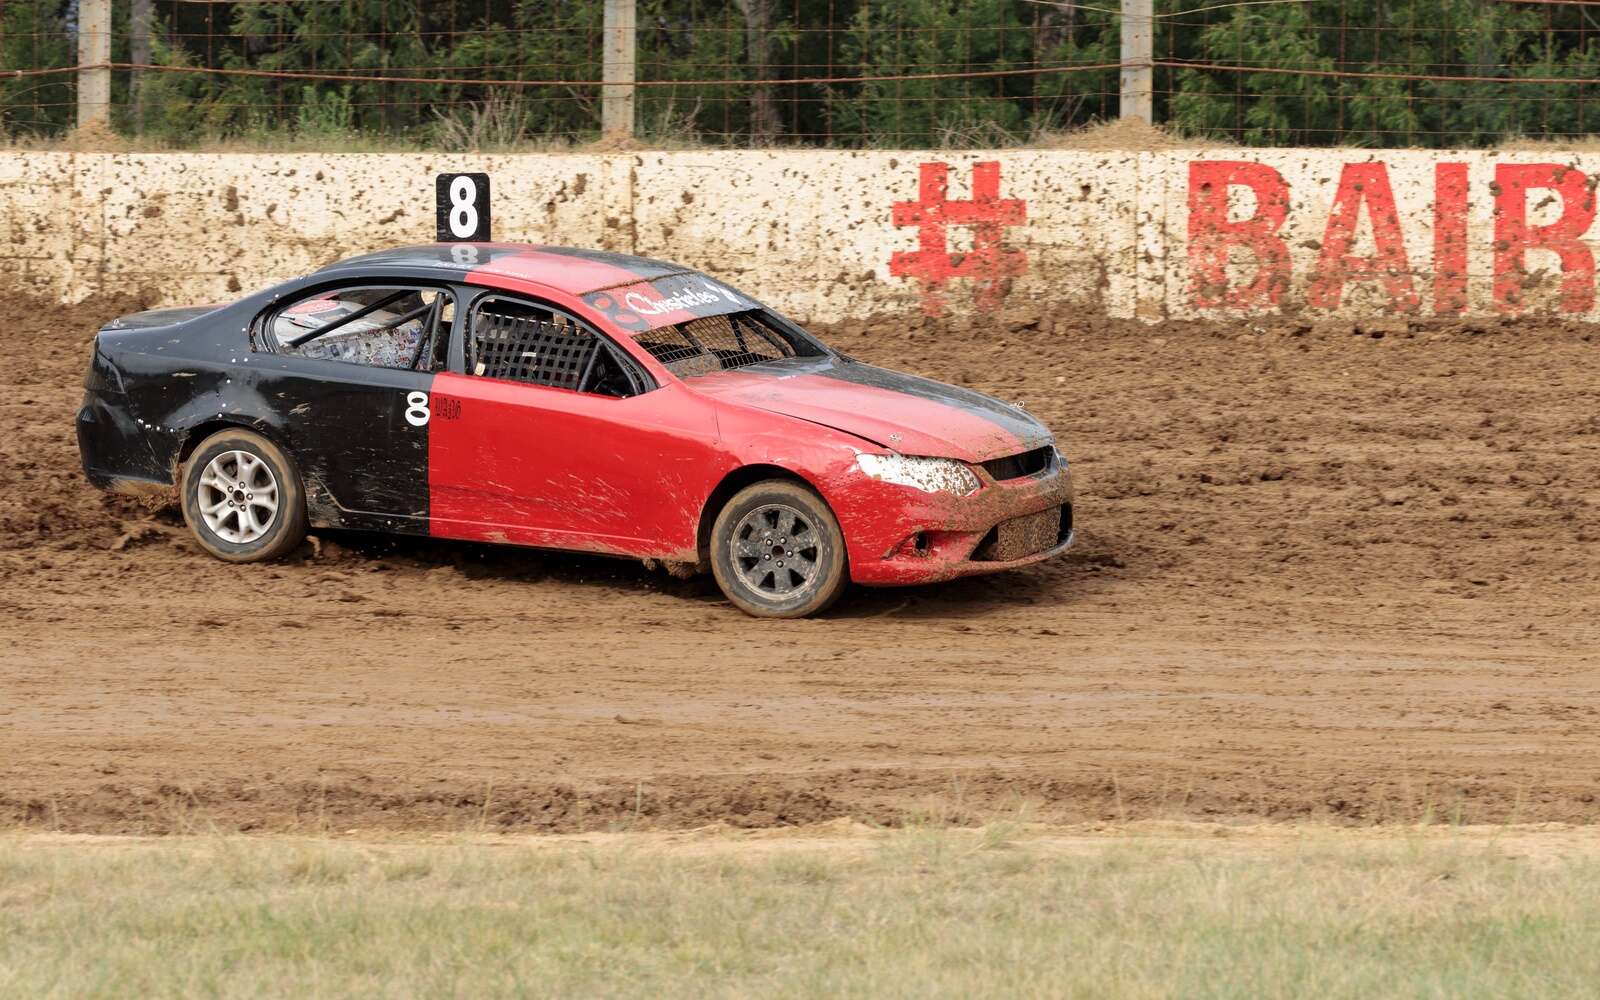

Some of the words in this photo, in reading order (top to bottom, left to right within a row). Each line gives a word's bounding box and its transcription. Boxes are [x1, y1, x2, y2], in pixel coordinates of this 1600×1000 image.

[449, 175, 478, 239] 8
[1187, 160, 1598, 313] BAIR
[583, 292, 649, 332] 8
[405, 391, 431, 427] 8
